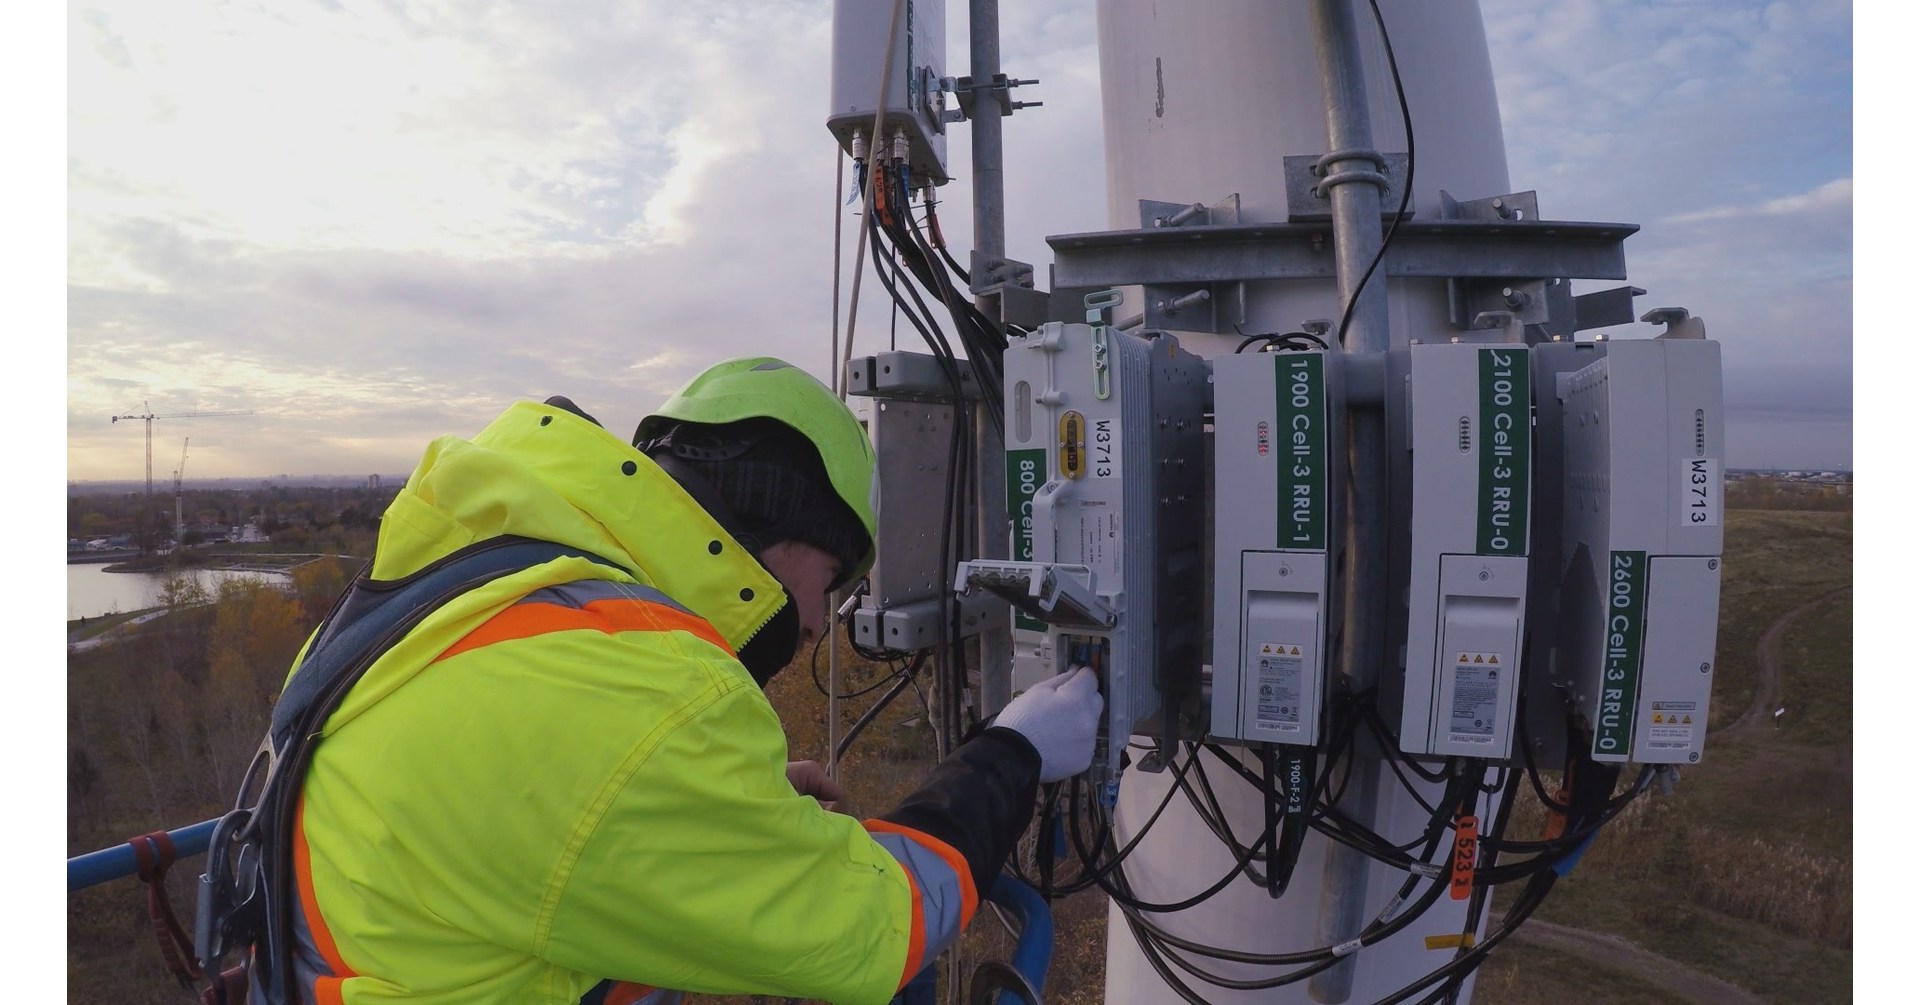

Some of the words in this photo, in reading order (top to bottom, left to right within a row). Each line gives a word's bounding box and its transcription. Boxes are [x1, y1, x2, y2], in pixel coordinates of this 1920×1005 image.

[1291, 360, 1310, 408] 1900
[1491, 349, 1512, 406] 2100
[1096, 420, 1111, 477] W3713
[1293, 414, 1311, 477] Cell-3
[1493, 412, 1512, 479] Cell-3
[1020, 460, 1035, 494] 800
[1691, 459, 1707, 523] W3713
[1293, 484, 1311, 541] RRU-1
[1490, 487, 1511, 550] RRU-0
[1613, 555, 1633, 608] 2600
[1607, 614, 1630, 681] Cell-3
[1599, 688, 1623, 750] RRU-0
[1290, 759, 1301, 803] 1900-F-2
[1456, 838, 1475, 872] 523
